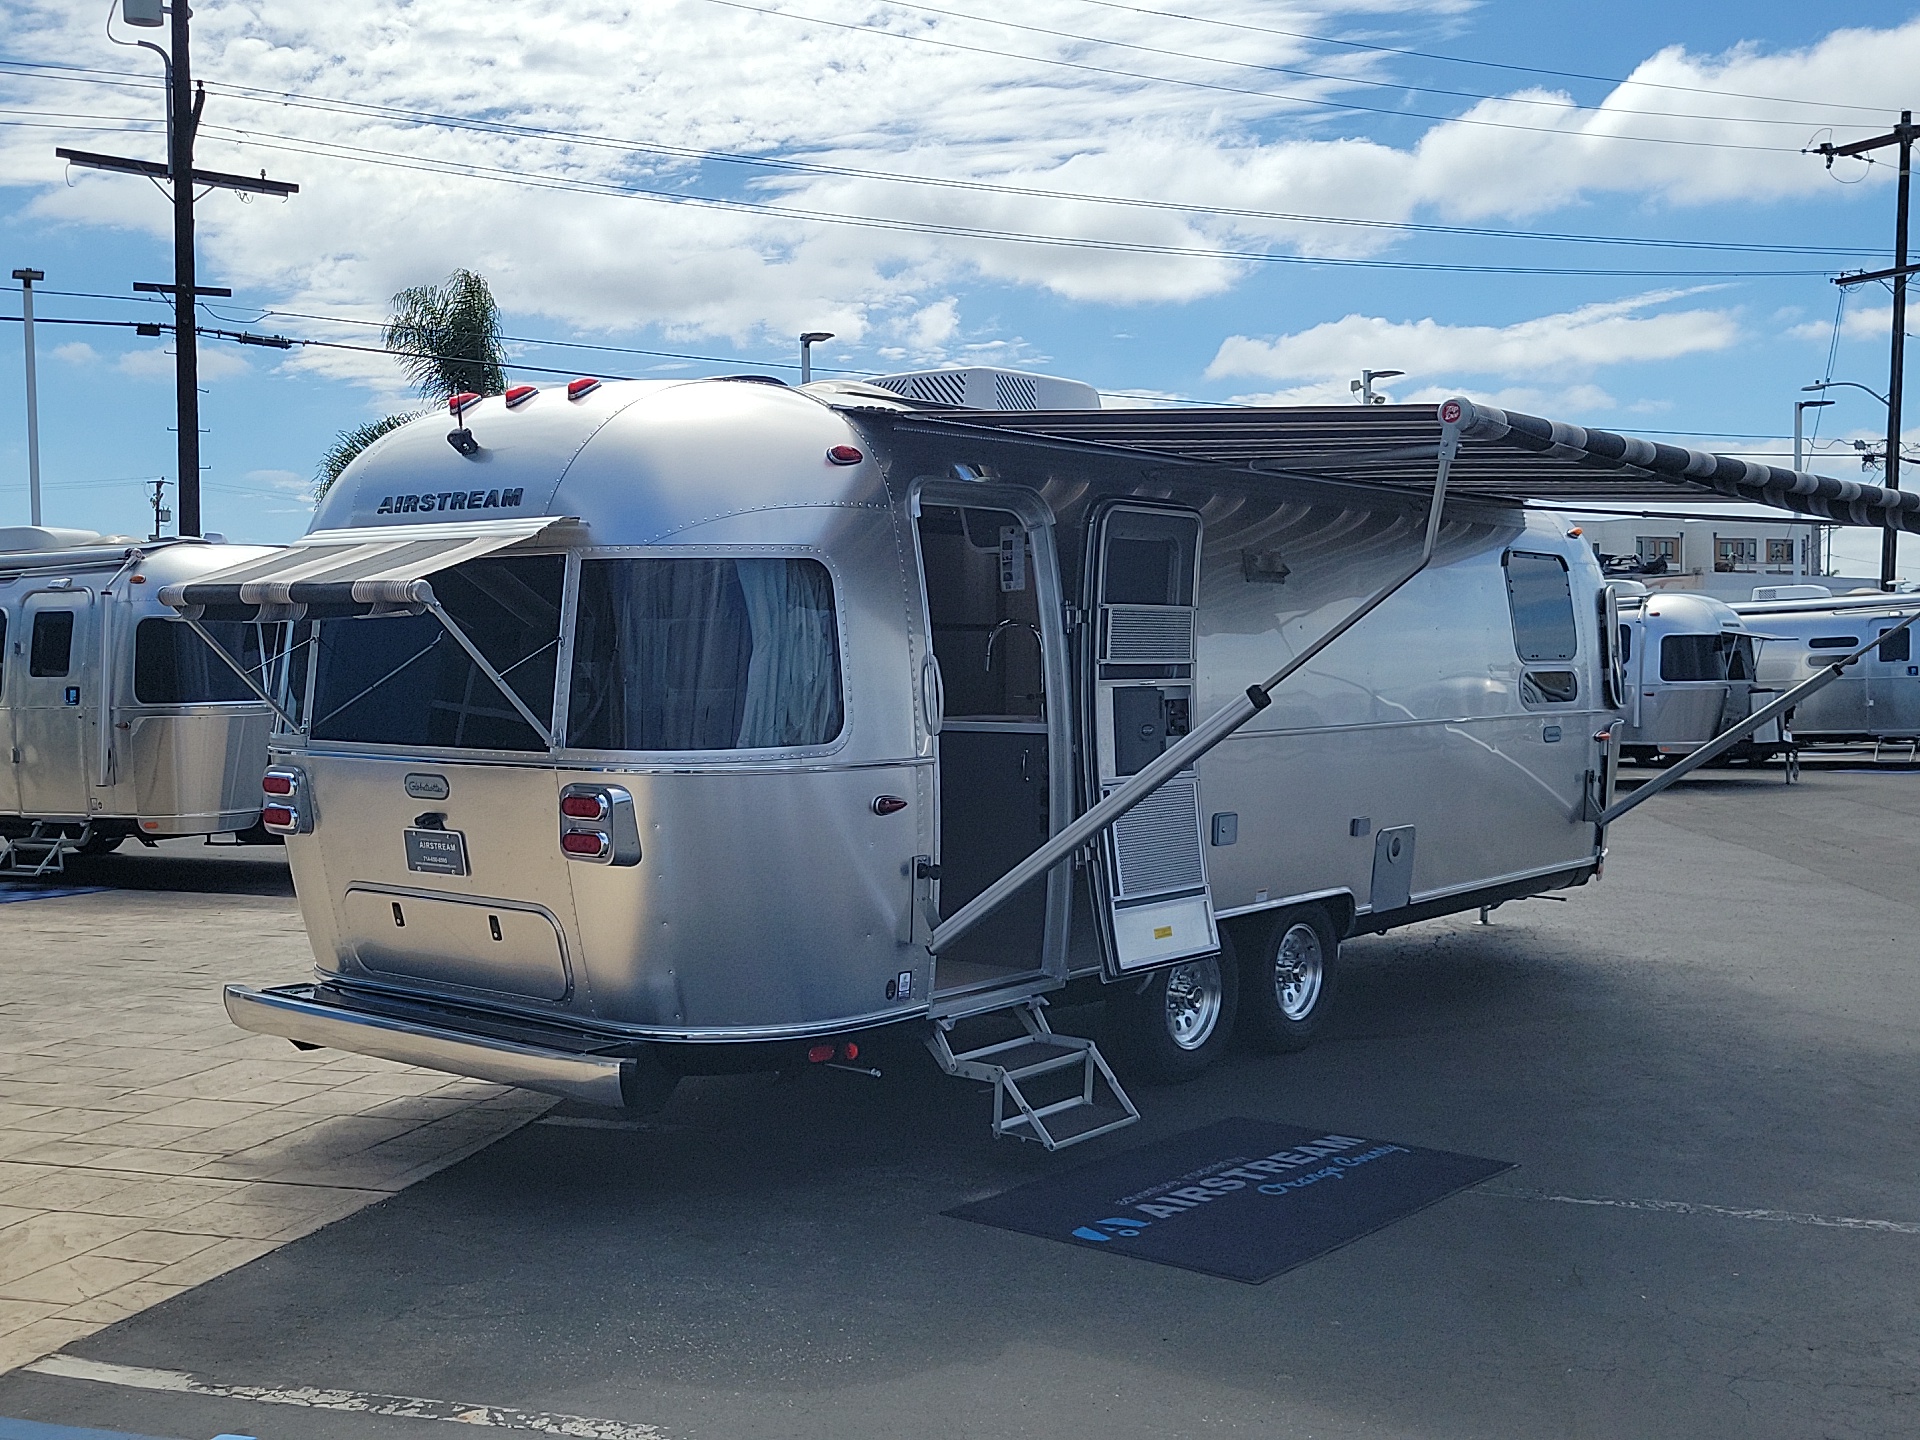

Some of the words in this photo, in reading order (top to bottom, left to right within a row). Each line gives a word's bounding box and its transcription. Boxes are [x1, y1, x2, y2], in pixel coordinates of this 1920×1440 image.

[376, 487, 524, 515] AIRSTREAM
[419, 840, 456, 852] AIRSTREAM
[1135, 1133, 1367, 1219] AIRSTREAM
[1257, 1166, 1345, 1195] Orange
[1332, 1143, 1411, 1167] County
